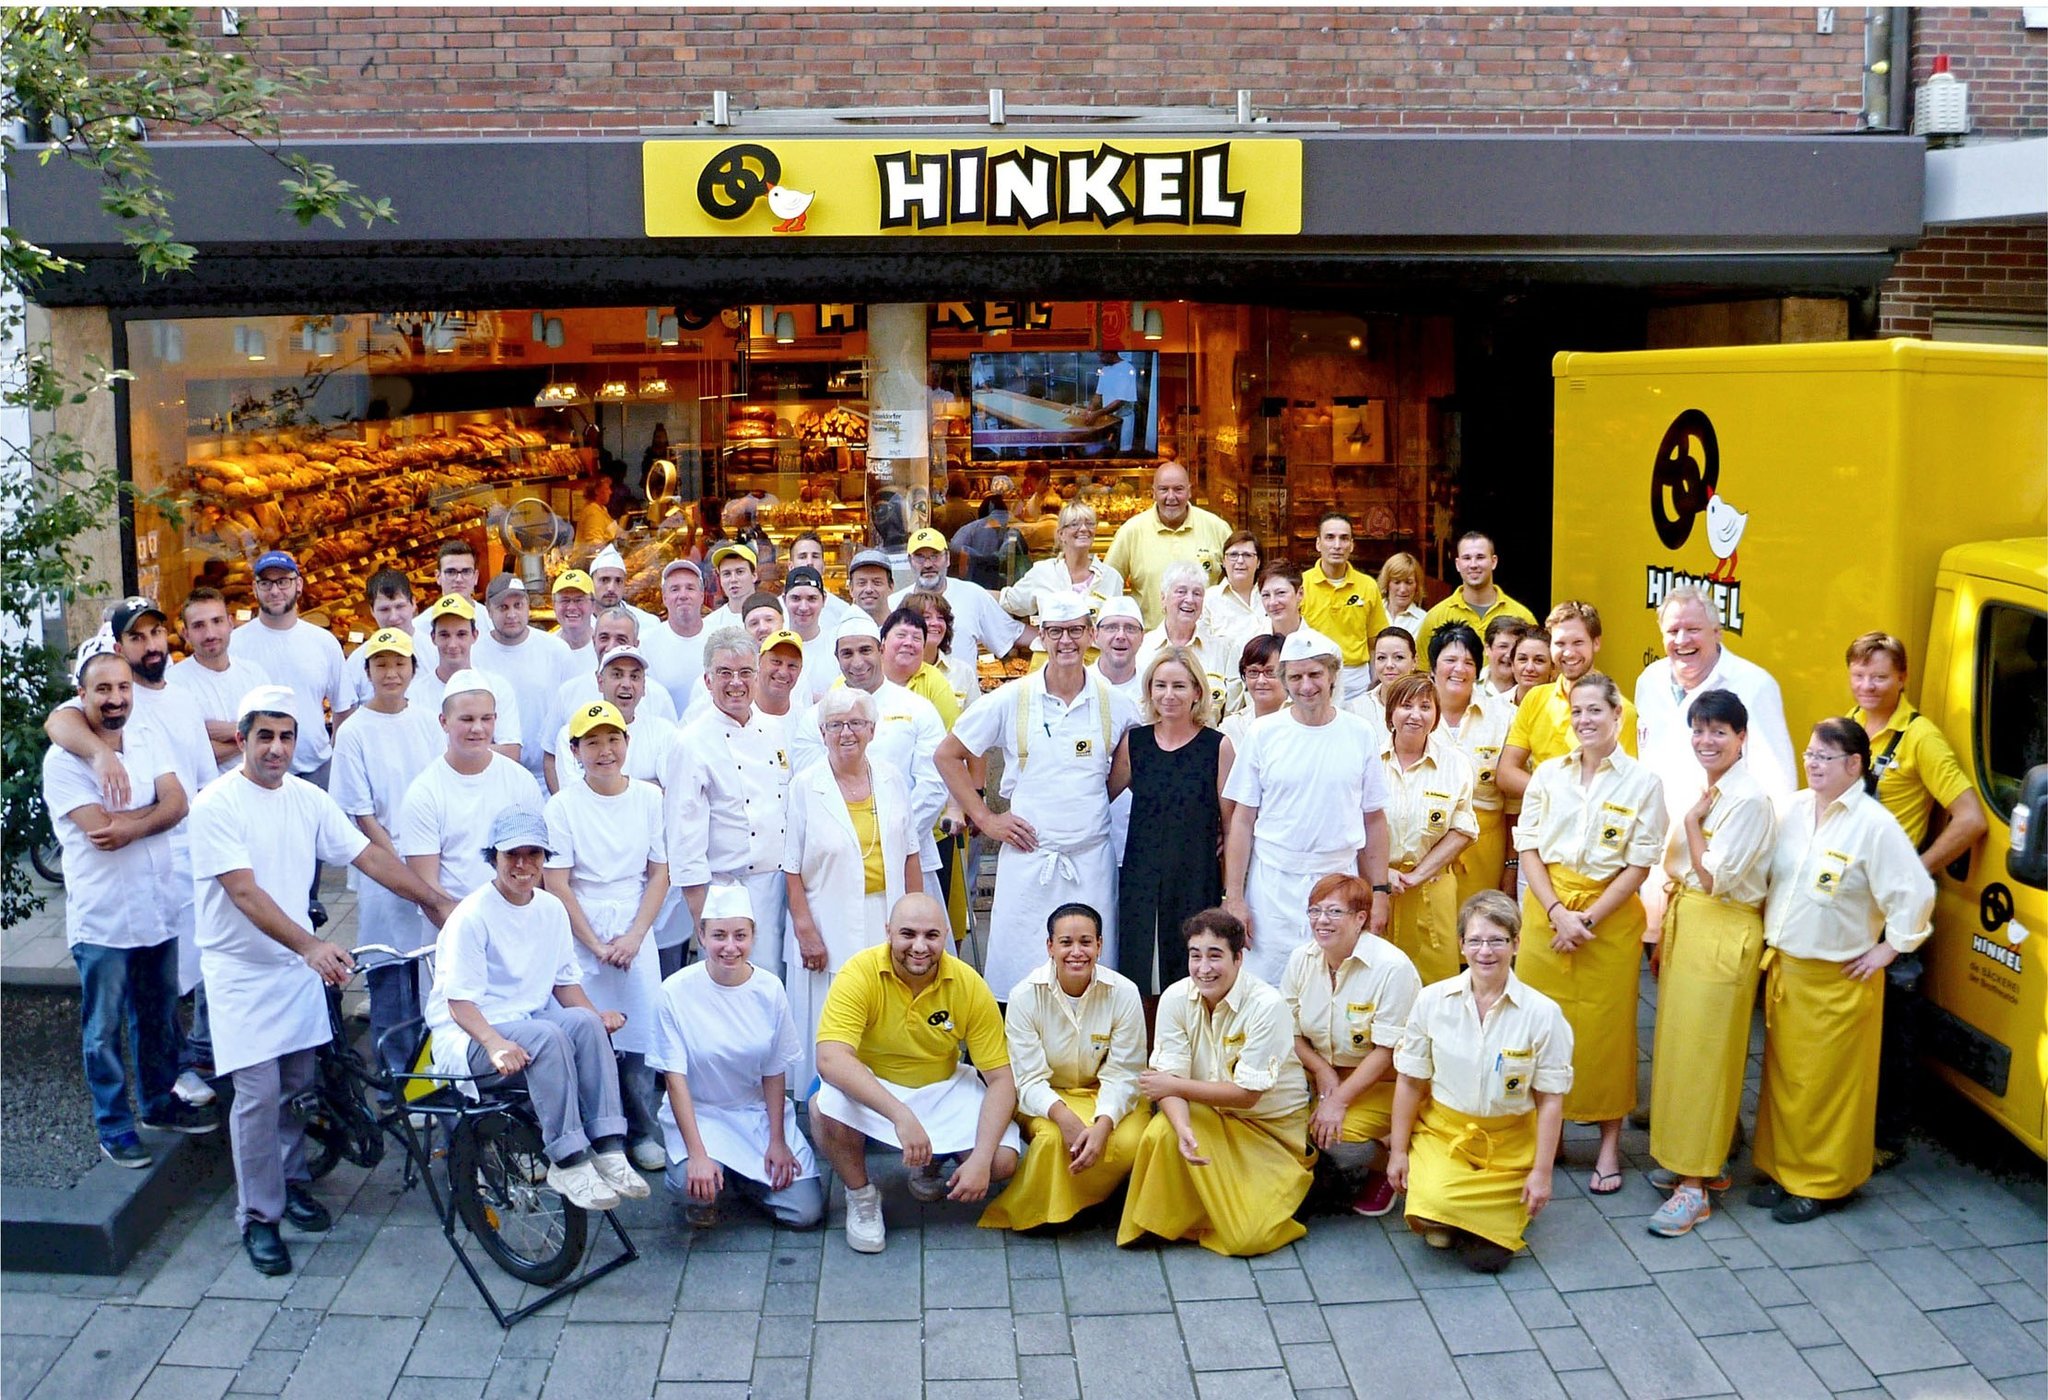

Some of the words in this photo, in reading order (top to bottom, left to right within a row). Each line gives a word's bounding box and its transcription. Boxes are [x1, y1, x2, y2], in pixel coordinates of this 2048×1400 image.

[875, 142, 1246, 230] HINKEL
[816, 302, 1053, 336] HKEL
[1972, 934, 2022, 974] HINKEL
